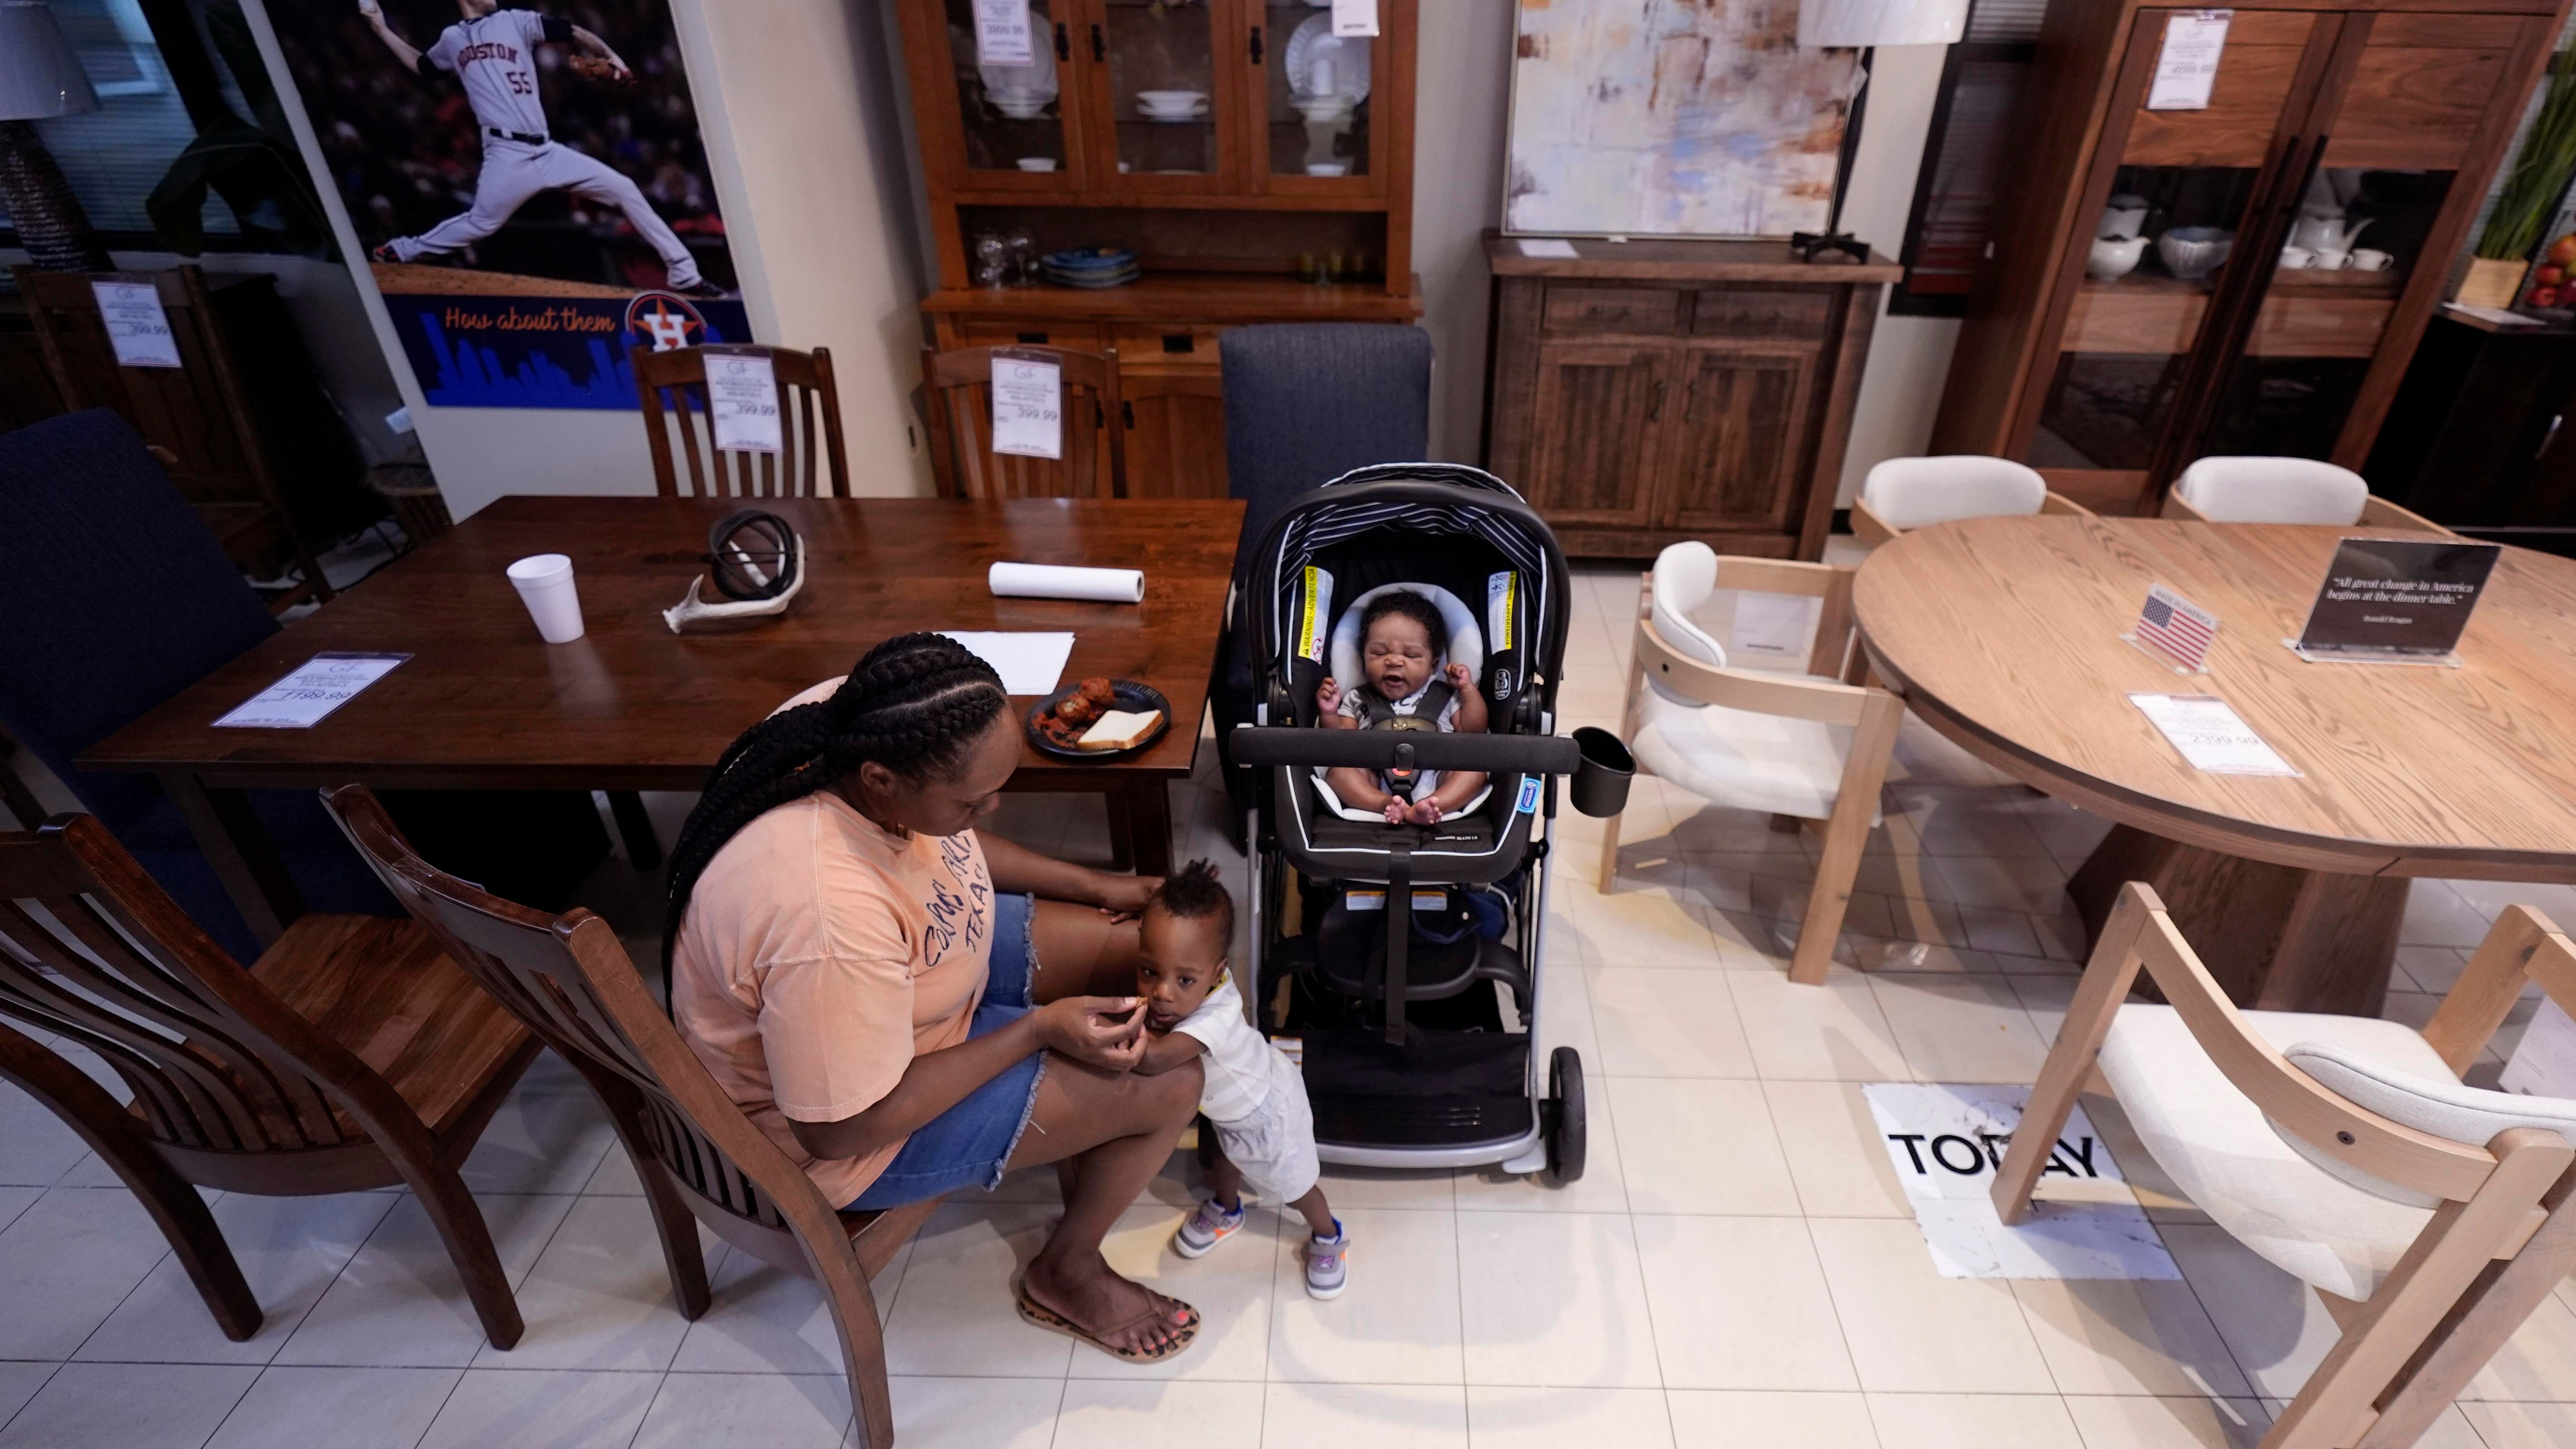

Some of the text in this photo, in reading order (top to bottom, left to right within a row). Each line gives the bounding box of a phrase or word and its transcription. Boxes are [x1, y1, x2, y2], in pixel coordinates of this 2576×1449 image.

[457, 43, 518, 71] HOUSTON
[506, 72, 532, 94] 55
[445, 306, 615, 332] How about them
[643, 313, 688, 352] H
[1017, 408, 1058, 421] 399.99
[2325, 589, 2360, 601] begins
[2361, 591, 2372, 601] at
[2373, 591, 2392, 602] the
[2392, 591, 2428, 603] dinner
[2352, 579, 2379, 590] great
[2380, 578, 2417, 591] change
[2417, 580, 2430, 591] in
[2431, 581, 2474, 593] America
[2154, 590, 2173, 603] MADE
[2182, 606, 2211, 627] AMERICA
[1303, 616, 1313, 647] WARNING
[2191, 734, 2258, 745] 2399.99
